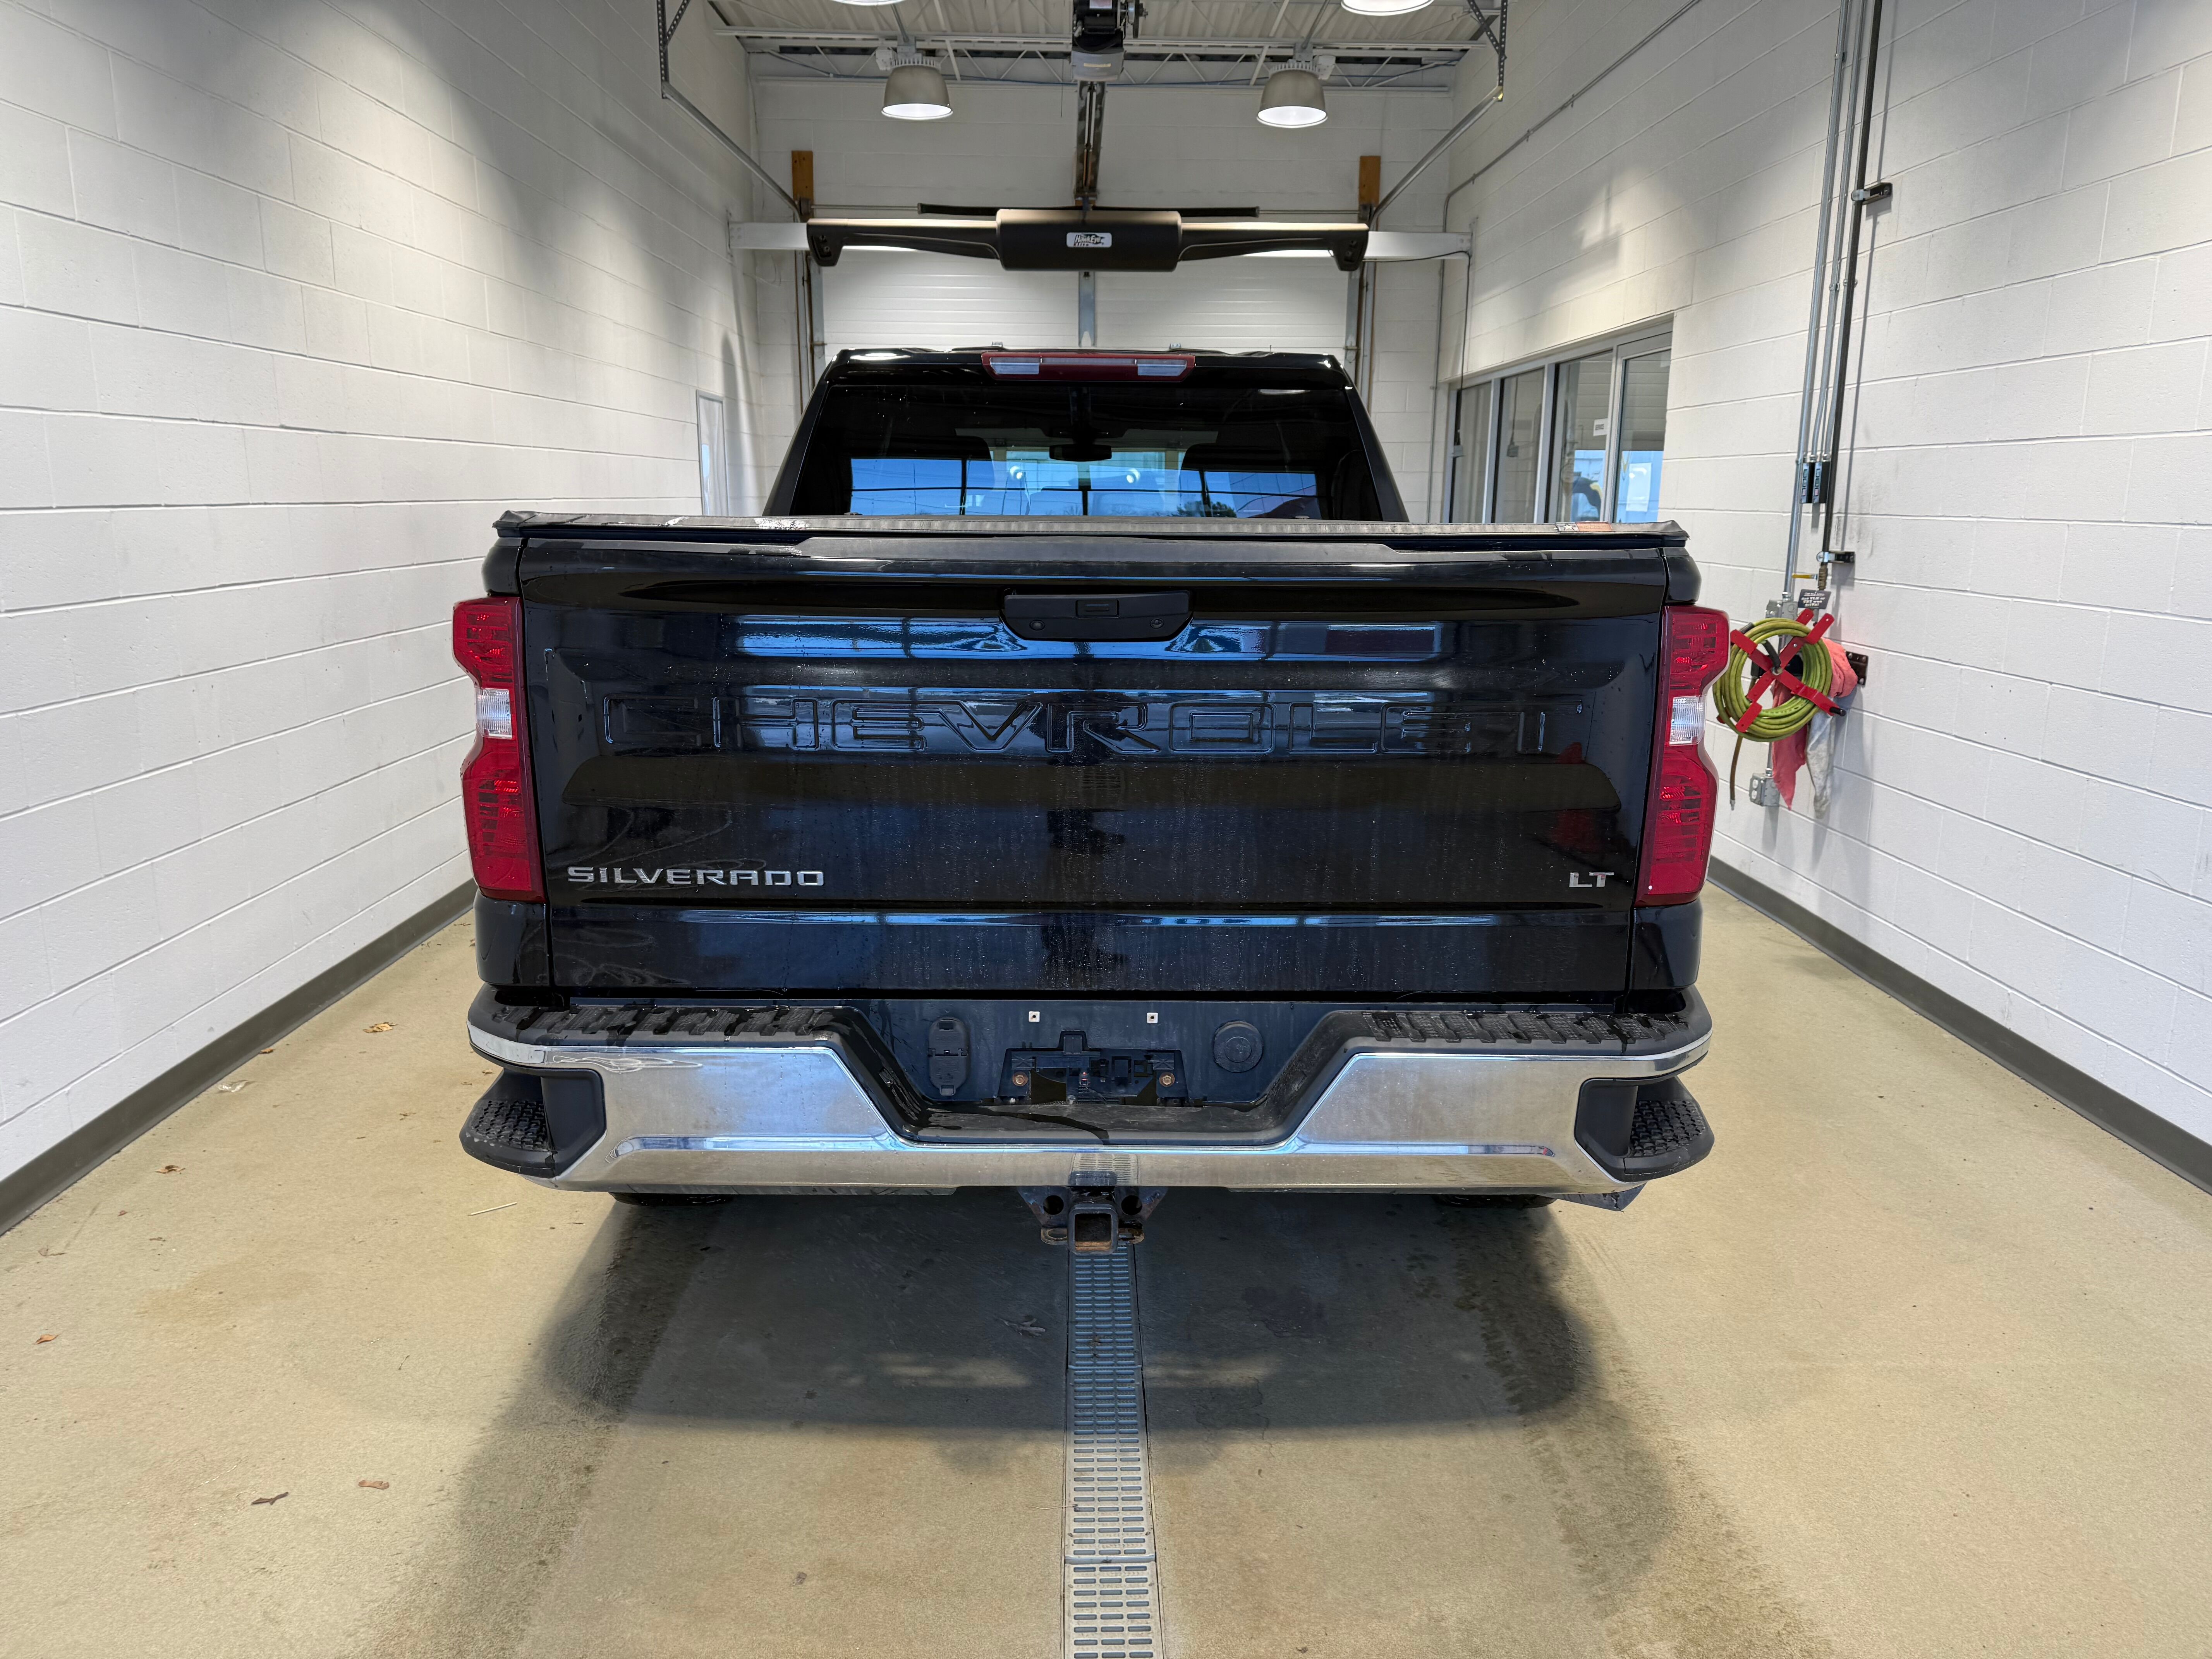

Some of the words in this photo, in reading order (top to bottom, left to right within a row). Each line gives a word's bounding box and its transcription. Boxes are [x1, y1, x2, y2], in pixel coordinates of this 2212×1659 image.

[603, 695, 1582, 753] CHEVROLET
[567, 866, 824, 886] SILVERADO
[1569, 872, 1614, 888] LT
